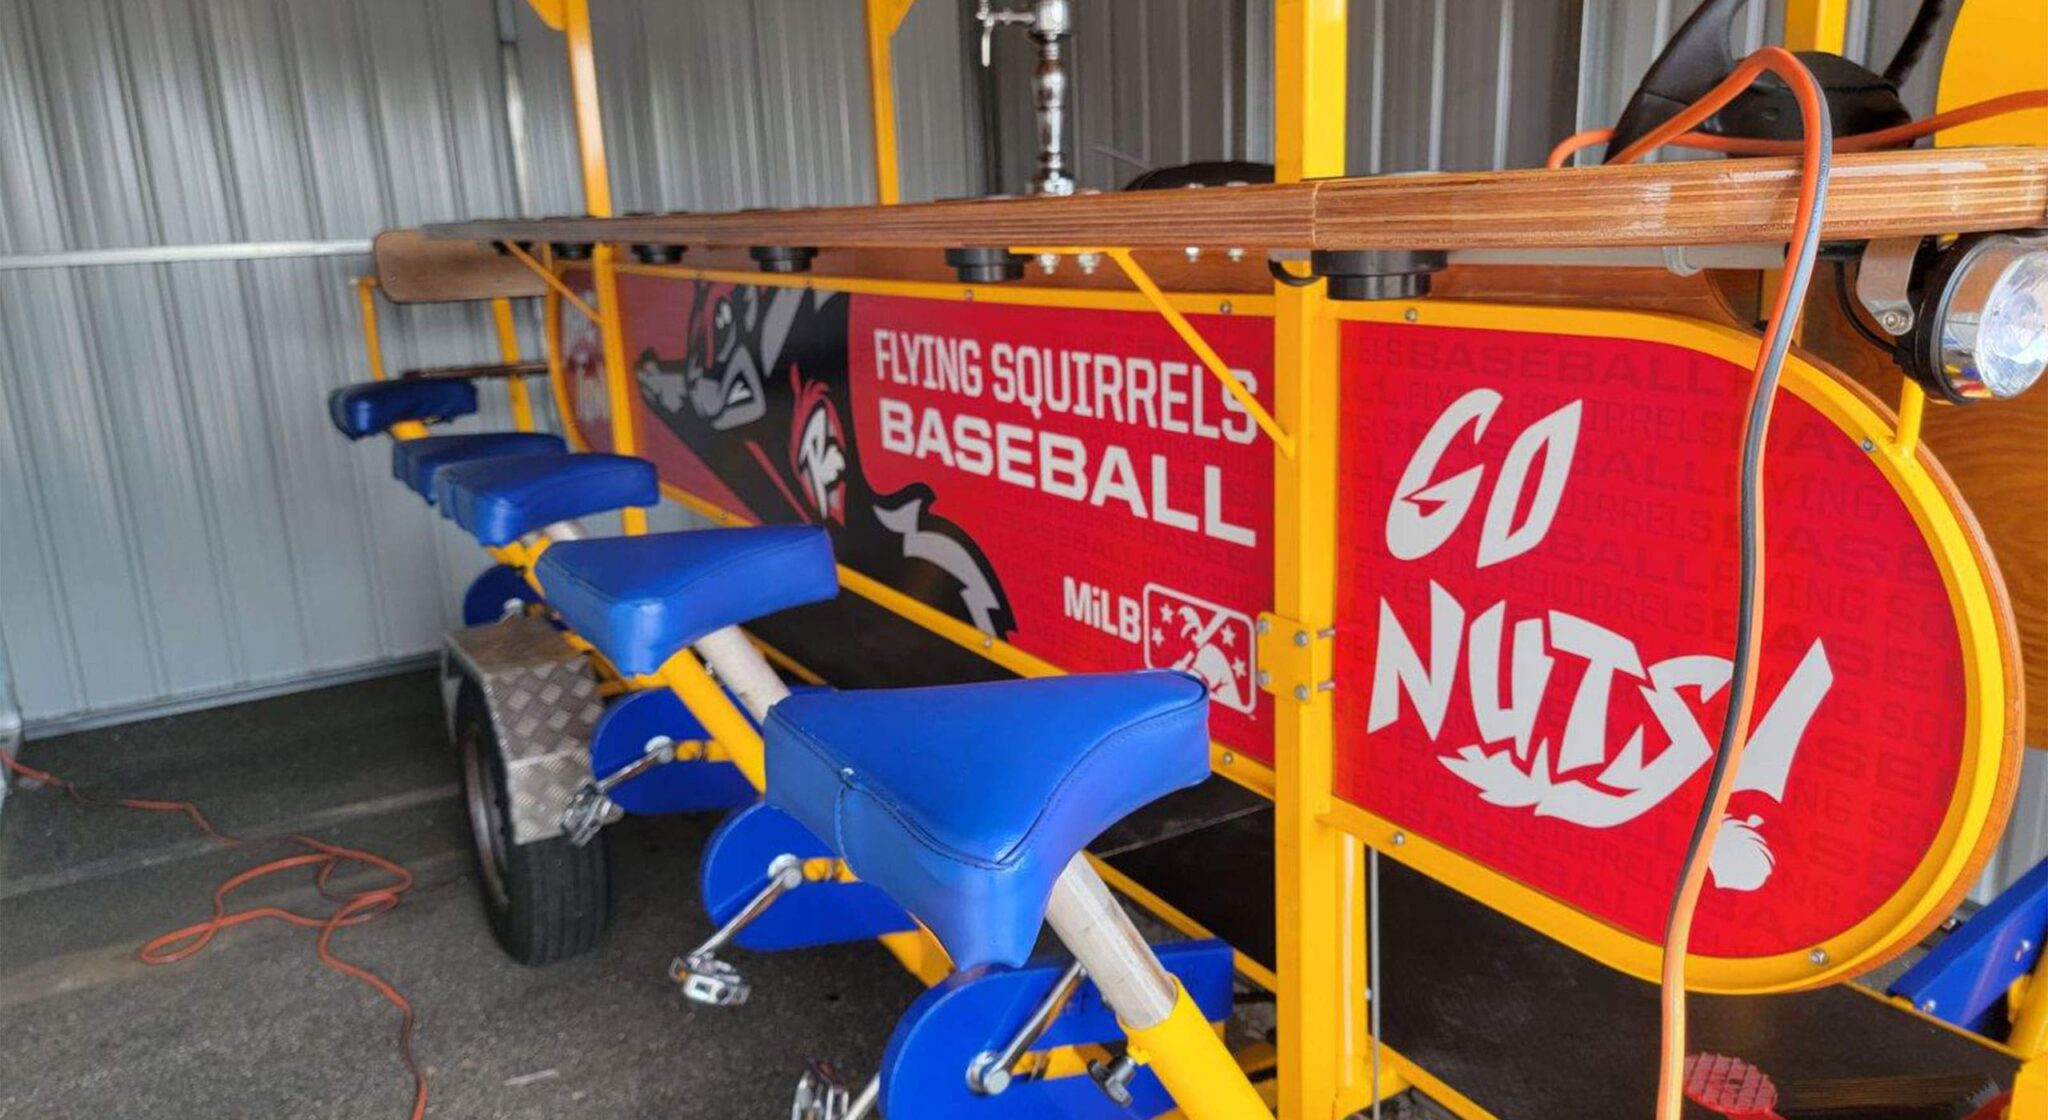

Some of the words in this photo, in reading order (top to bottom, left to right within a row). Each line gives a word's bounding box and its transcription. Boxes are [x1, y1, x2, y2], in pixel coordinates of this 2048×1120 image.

[874, 329, 983, 398] FLYING
[991, 342, 1258, 445] SQUIRRELS
[879, 398, 1256, 548] BASEBALL
[1386, 387, 1583, 569] GO
[1063, 576, 1142, 644] MiLB
[1367, 578, 1834, 890] NUTS!
